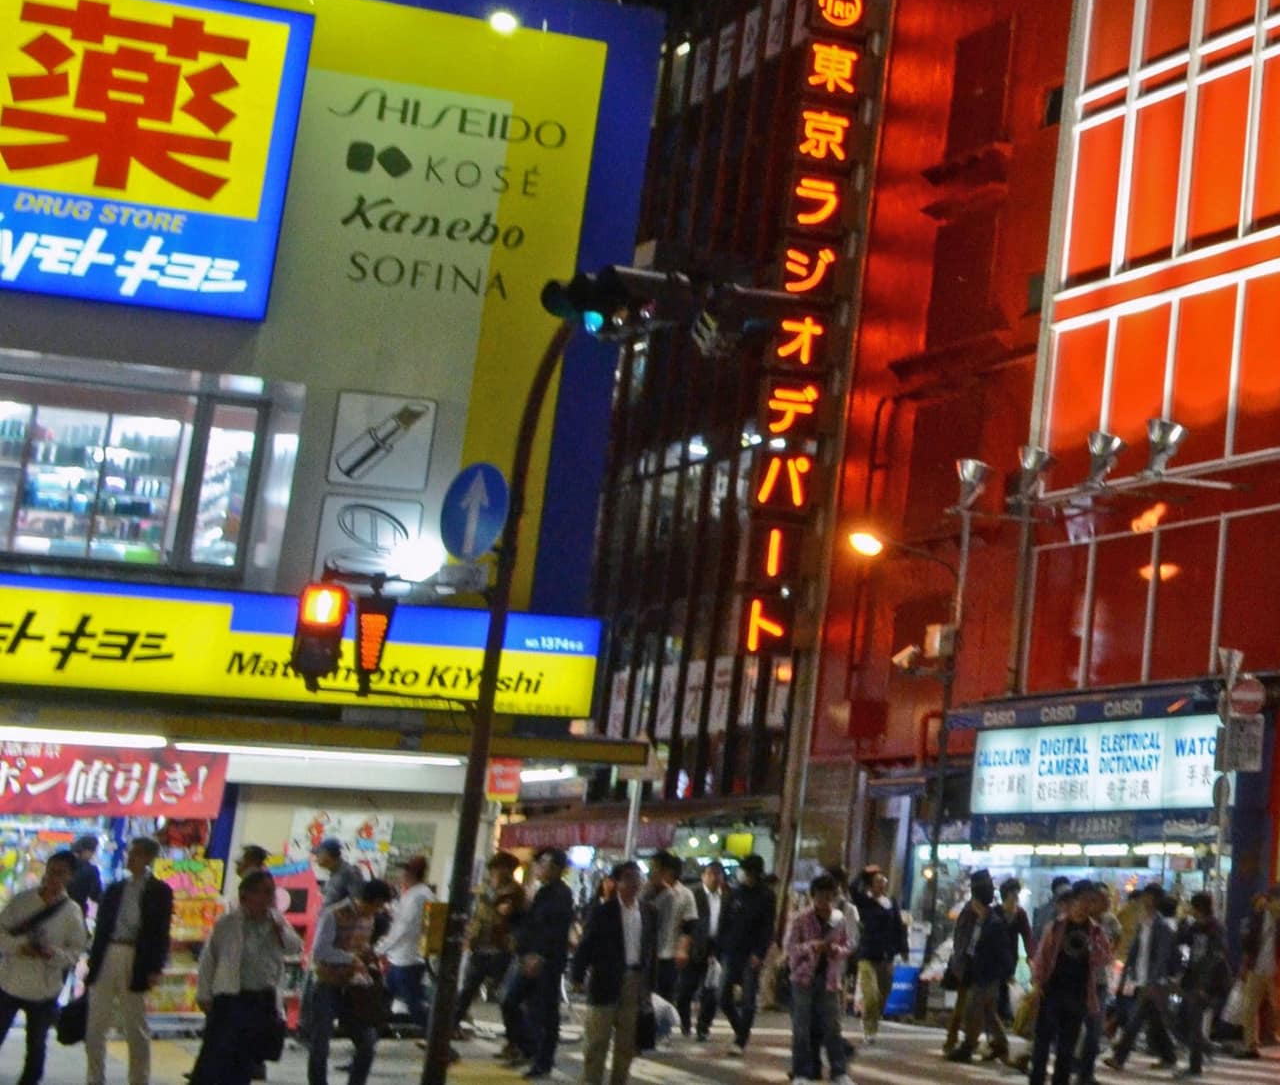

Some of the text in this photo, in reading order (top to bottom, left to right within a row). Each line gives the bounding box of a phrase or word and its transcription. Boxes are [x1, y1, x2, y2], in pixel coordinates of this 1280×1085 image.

[327, 87, 568, 150] SHISEIDO
[424, 158, 542, 197] KOSÉ
[13, 191, 187, 235] DRUG STORE
[340, 194, 526, 250] Kanebo
[345, 252, 509, 301] SOFINA
[747, 42, 858, 653] 東京ラジオデパート
[226, 651, 545, 696] Matmoto KiYshi
[984, 710, 1017, 727] CASIO
[1040, 704, 1077, 723] CASIO
[1103, 699, 1143, 717] CASIO
[1040, 736, 1088, 756] DIGITAL
[1101, 731, 1162, 753] ELECTRICAL
[978, 747, 1031, 768] CALCULATOR
[1038, 757, 1090, 777] CAMERA
[1098, 754, 1162, 774] DICTIONARY
